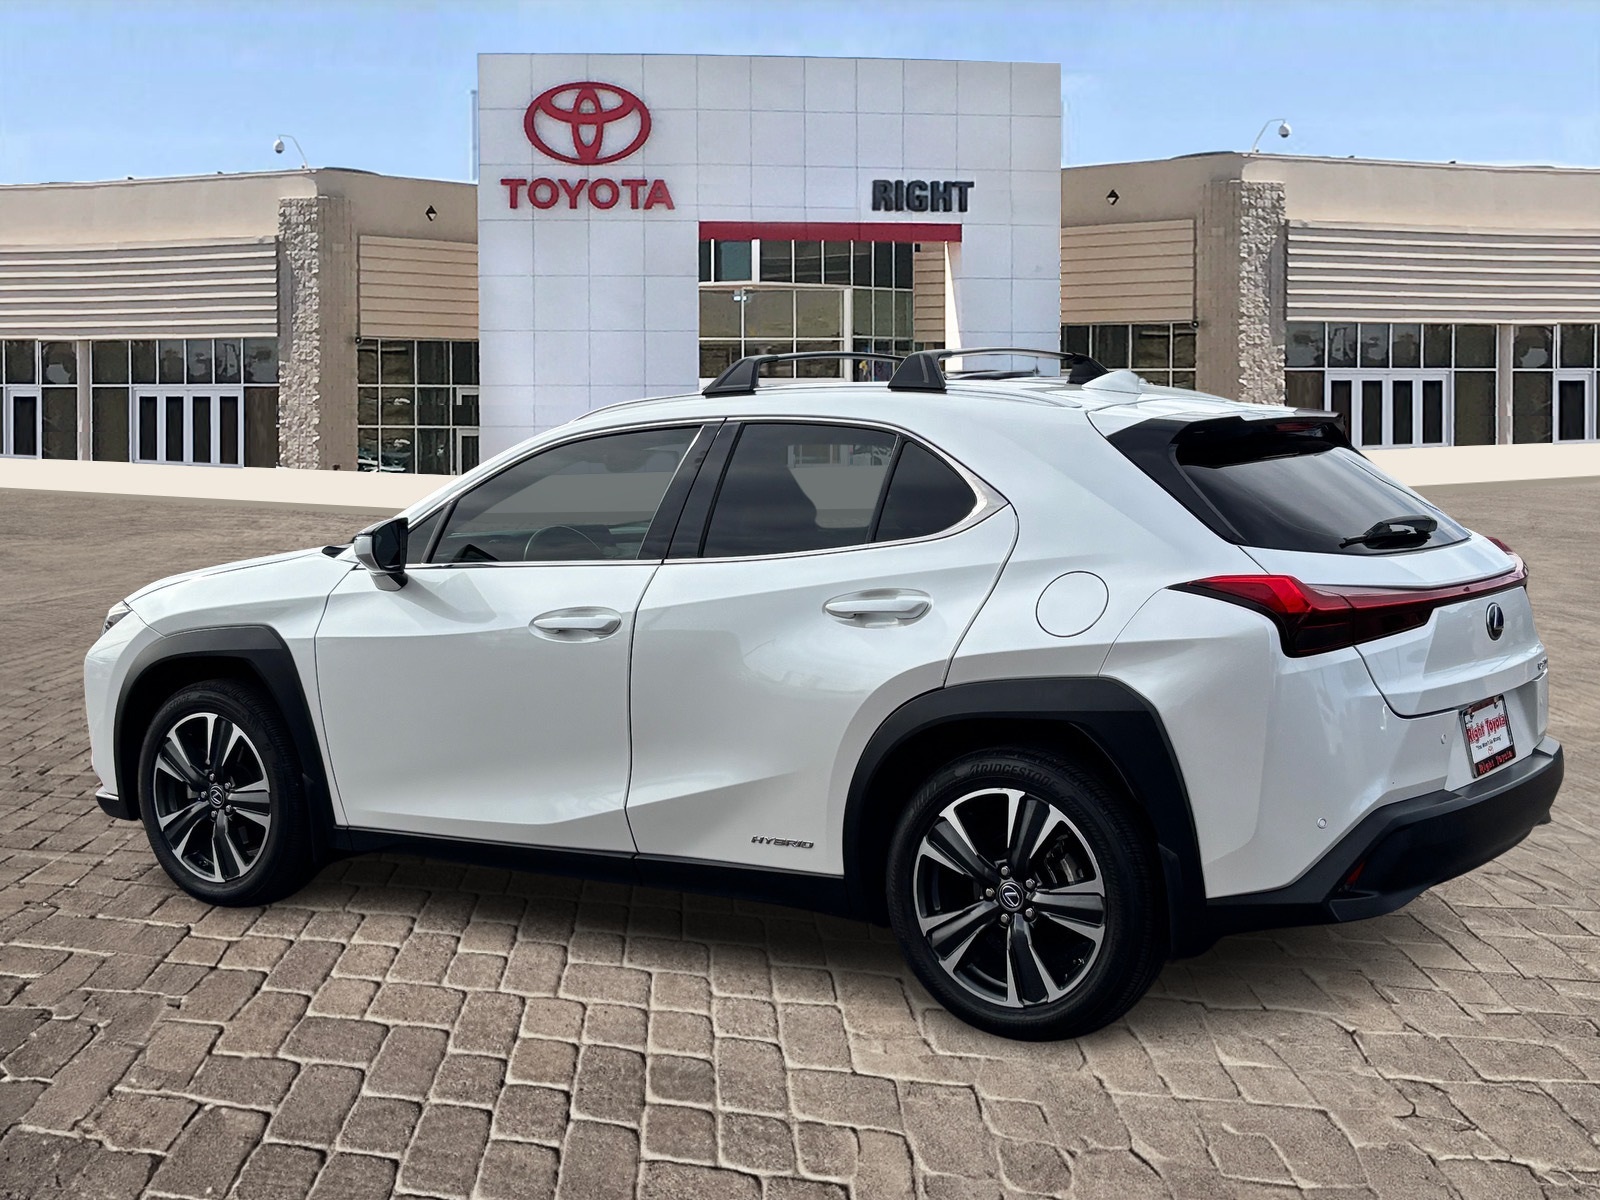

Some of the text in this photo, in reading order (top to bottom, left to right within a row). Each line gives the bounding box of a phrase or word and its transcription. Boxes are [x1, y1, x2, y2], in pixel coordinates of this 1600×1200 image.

[501, 178, 675, 209] TOYOTA
[872, 180, 975, 212] RIGHT
[1466, 714, 1506, 744] Right Toyota
[1479, 751, 1513, 774] Right Toyota
[751, 836, 814, 848] HYBRID
